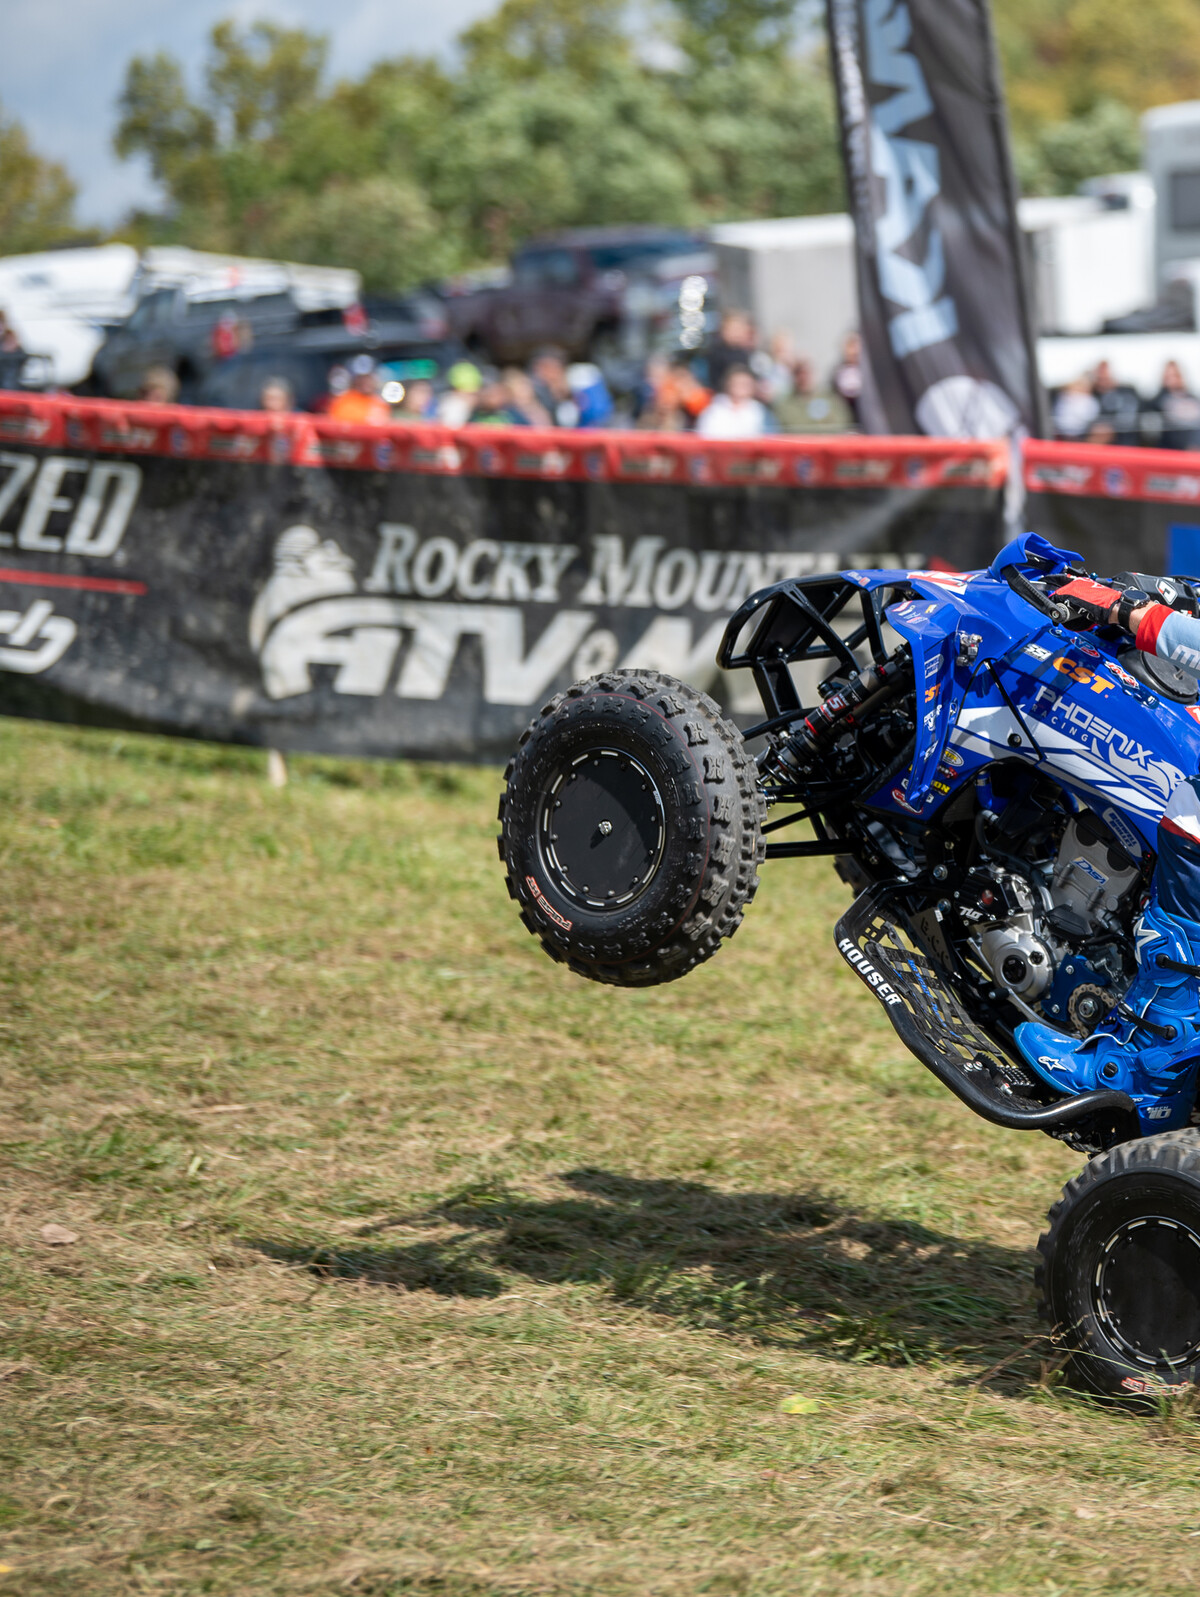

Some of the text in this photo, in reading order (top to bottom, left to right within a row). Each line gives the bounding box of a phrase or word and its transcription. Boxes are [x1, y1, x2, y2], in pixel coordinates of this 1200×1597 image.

[365, 522, 577, 602] ROCKY
[1053, 656, 1115, 694] CST
[1032, 703, 1088, 742] RACING
[1035, 685, 1153, 767] PHOENIX
[838, 938, 902, 1005] HOUSER
